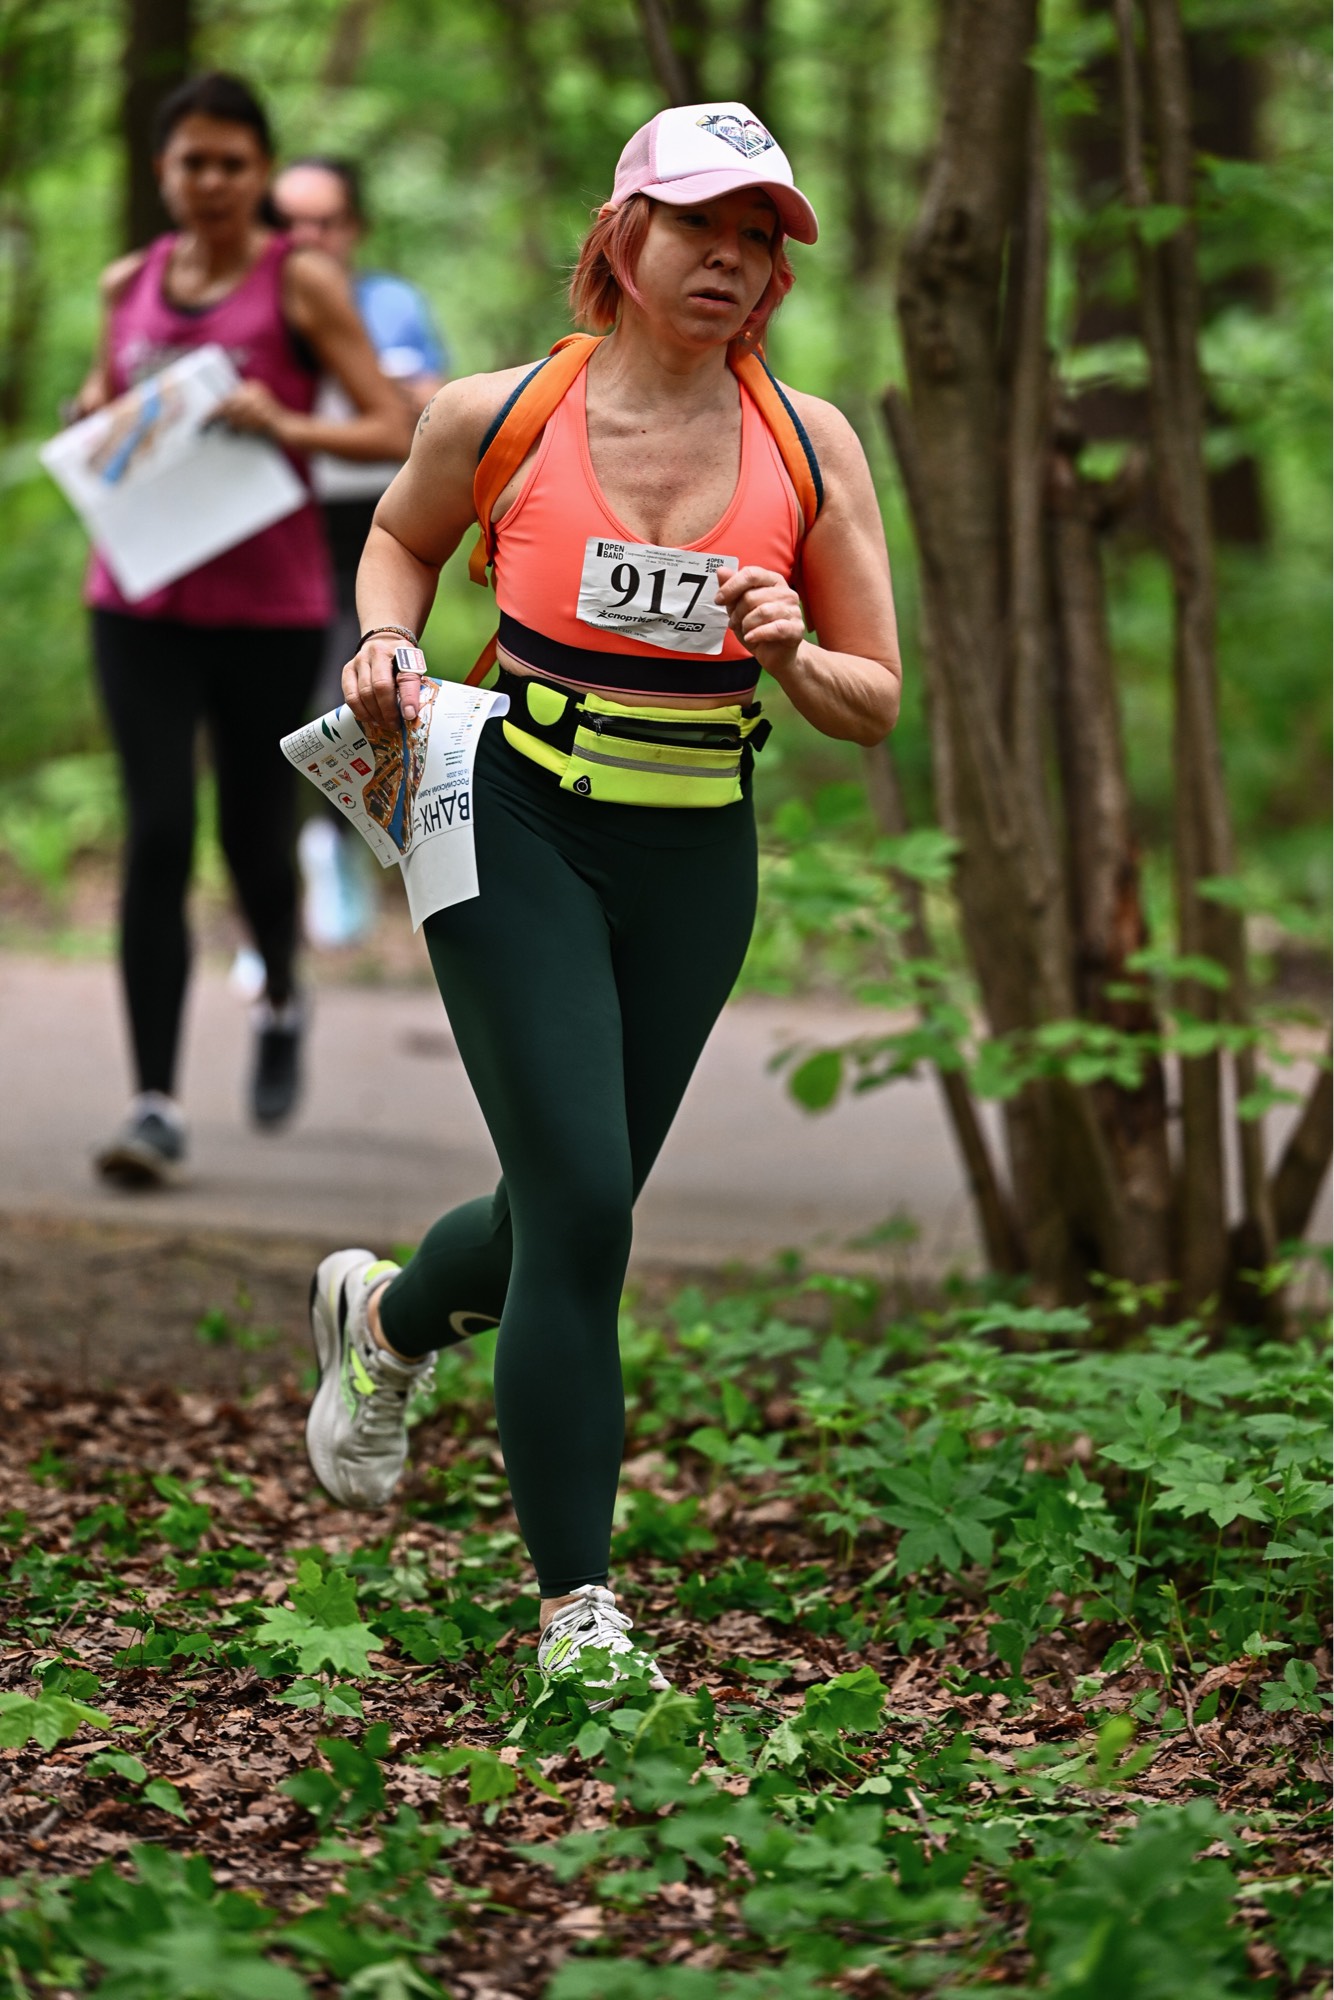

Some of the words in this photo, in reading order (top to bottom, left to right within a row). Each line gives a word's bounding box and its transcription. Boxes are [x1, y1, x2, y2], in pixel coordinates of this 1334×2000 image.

[603, 551, 624, 560] BAND
[604, 543, 625, 552] OPEN
[607, 563, 709, 619] 917
[607, 612, 676, 626] спортМатер
[676, 622, 703, 631] PRO
[431, 777, 470, 796] Российский
[419, 790, 470, 836] ВДНХ
